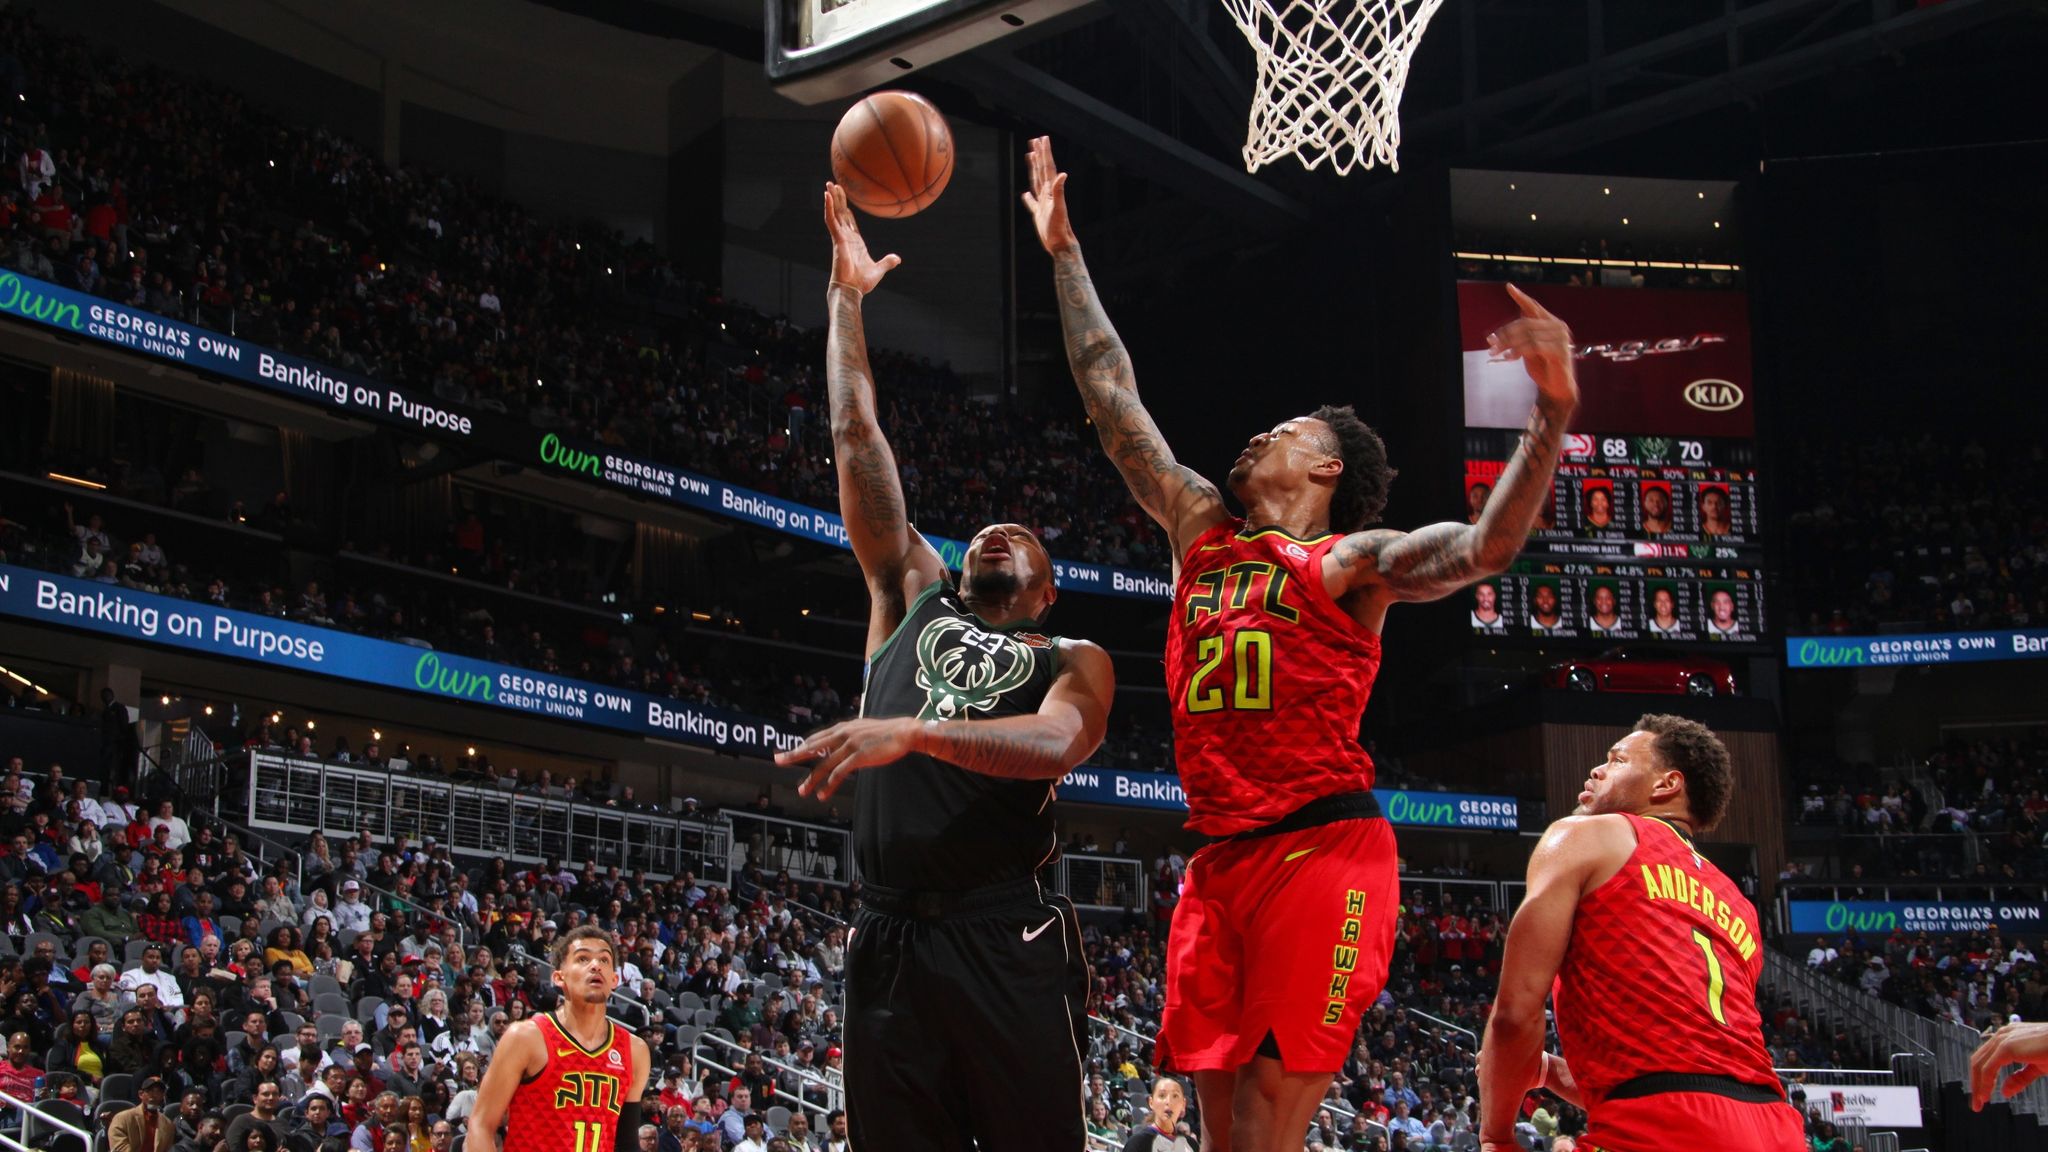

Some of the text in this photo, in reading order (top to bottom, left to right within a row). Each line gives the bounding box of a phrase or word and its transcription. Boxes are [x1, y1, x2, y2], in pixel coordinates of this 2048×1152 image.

[0, 273, 84, 330] Own
[89, 323, 186, 359] CREDIT UNION
[90, 305, 241, 362] GEORGIA'S OWN
[259, 354, 472, 434] Banking on Purpose
[1695, 385, 1734, 404] KIA
[540, 433, 601, 477] Own
[1602, 438, 1628, 458] 68
[1678, 441, 1704, 460] 70
[604, 470, 672, 497] CREDIT UNION
[605, 455, 710, 496] GEORGIA'S OWN
[1747, 472, 1754, 482] 4
[722, 488, 849, 543] Banking on Purp
[1549, 543, 1569, 553] FREE
[1571, 544, 1599, 554] THROW
[1601, 544, 1620, 554] RATE
[1716, 547, 1738, 559] 25%
[1069, 566, 1100, 583] OWN
[1564, 564, 1593, 575] 47.9%
[1615, 566, 1644, 576] 44.8%
[1665, 567, 1695, 578] 91.7%
[1721, 569, 1728, 579] 4
[1185, 560, 1300, 627] ATL
[36, 579, 325, 661] Banking on Purpose
[960, 627, 1007, 655] 23
[1799, 639, 1866, 665] Own
[1869, 637, 1996, 653] GEORGIA'S OWN
[1186, 627, 1274, 715] 20
[1870, 651, 1950, 663] CREDIT UNION
[414, 651, 495, 700] Own
[498, 692, 584, 718] CREDIT UNION
[499, 673, 632, 713] GEORGIA'S OWN
[648, 702, 728, 744] Banking
[732, 723, 757, 746] on
[1063, 773, 1099, 789] OWN
[1388, 791, 1456, 825] Own
[1459, 799, 1518, 816] GEORGI
[1460, 815, 1498, 827] CREDIT
[1640, 864, 1757, 962] ANDERSON
[1825, 902, 1897, 932] Own
[1903, 906, 2040, 920] GEORGIA'S OWN
[1904, 919, 1990, 931] CREDIT UNION
[1321, 888, 1366, 1025] HAWKS
[1692, 927, 1729, 1027] 1
[554, 1071, 621, 1116] ATL
[574, 1120, 602, 1152] 11
